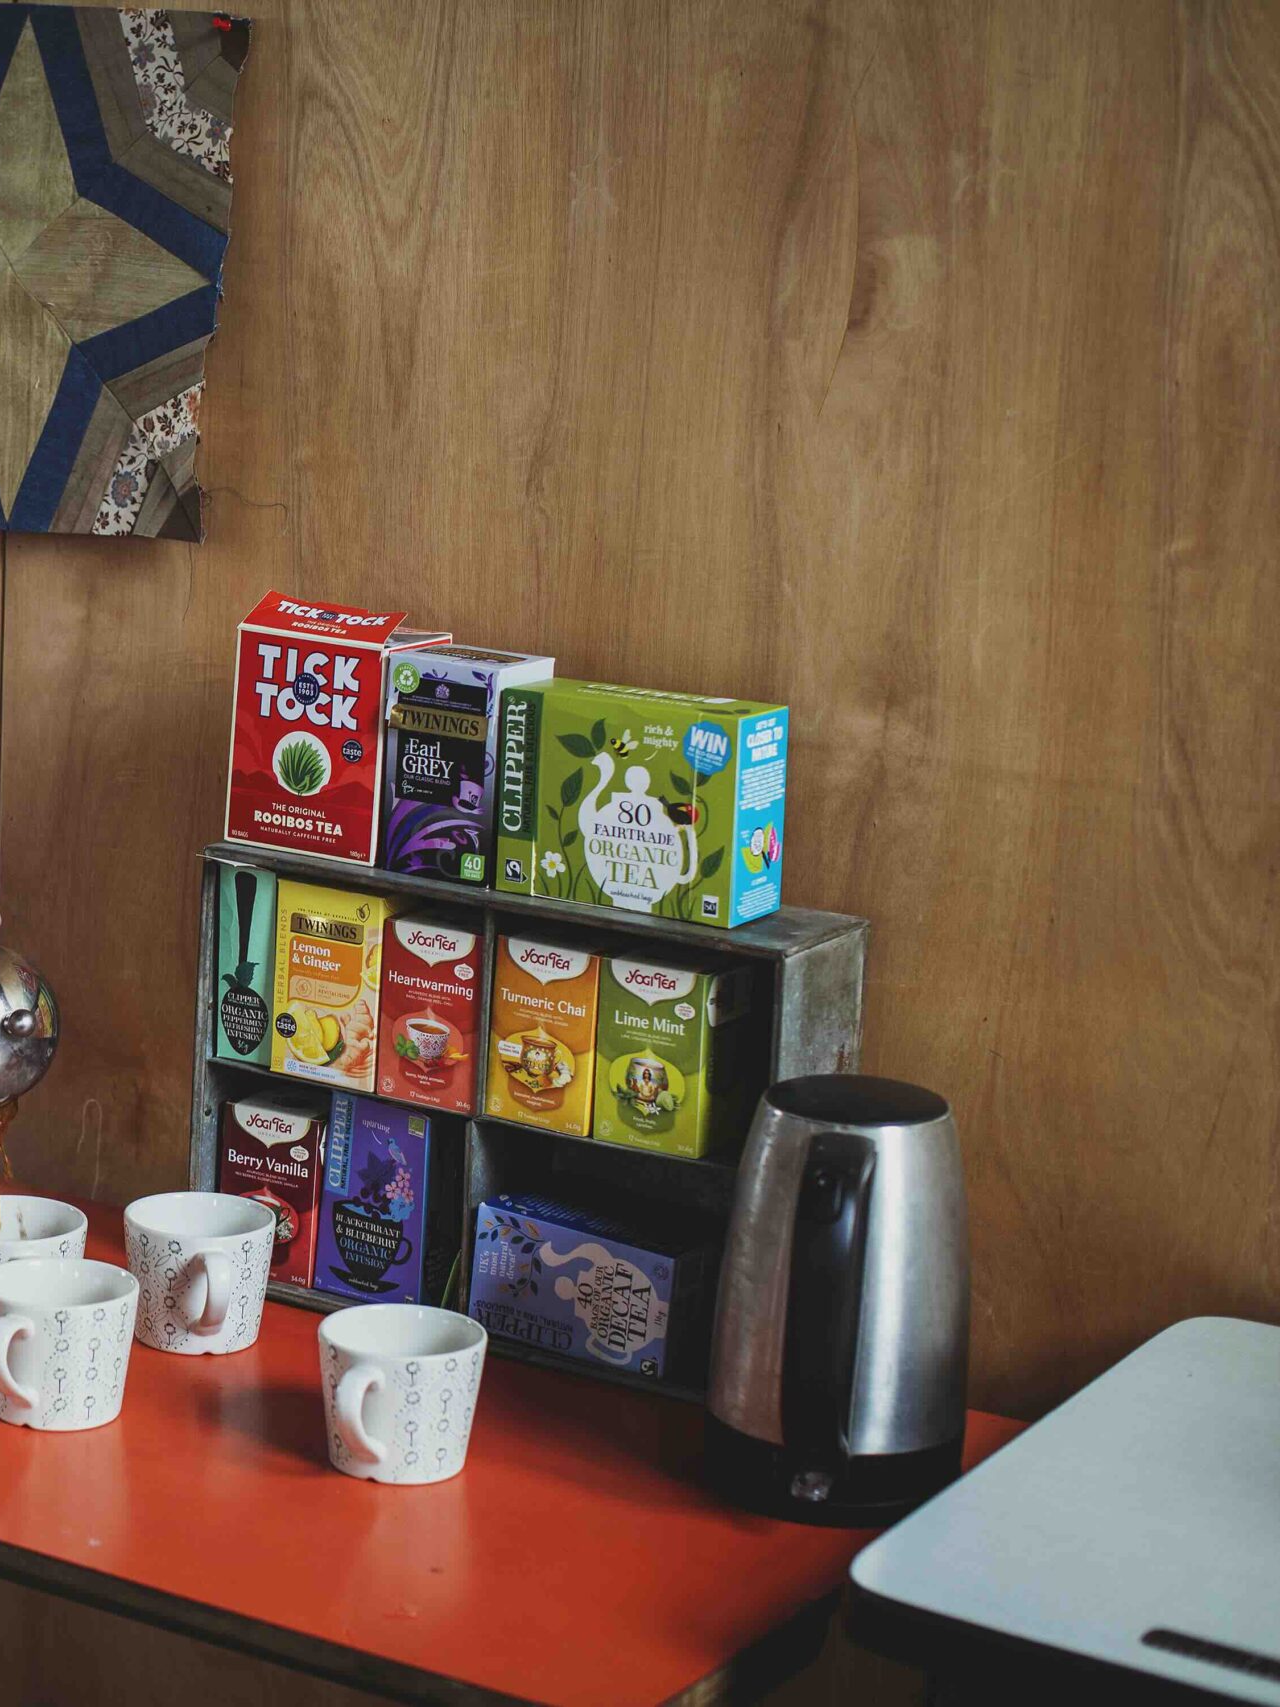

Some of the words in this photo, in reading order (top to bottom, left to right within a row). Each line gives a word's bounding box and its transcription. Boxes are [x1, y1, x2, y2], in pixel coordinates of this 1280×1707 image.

[277, 600, 322, 620] TICK
[336, 614, 390, 626] TOCK
[292, 622, 328, 632] ROOIBOS
[258, 644, 360, 692] TICK
[256, 682, 358, 731] TOCK
[402, 708, 480, 736] TWININGS
[644, 724, 664, 735] rich
[664, 727, 674, 737] &
[343, 747, 362, 757] taste
[410, 738, 441, 759] Earl
[643, 735, 679, 752] mighty
[690, 726, 728, 756] WIN
[402, 754, 454, 780] GREY
[502, 700, 528, 832] CLIPPER
[415, 775, 434, 783] CLASSIC
[272, 802, 286, 812] THE
[288, 806, 326, 819] ORIGINAL
[618, 801, 652, 826] 80
[238, 830, 249, 838] BAGS
[254, 810, 313, 831] ROOIBOS
[316, 821, 342, 836] TEA
[260, 826, 292, 836] NATURALLY
[293, 831, 320, 841] CAFFEINE
[322, 836, 336, 844] FREE
[594, 823, 676, 846] FAIRTRADE
[464, 856, 481, 871] 40
[589, 839, 678, 866] ORGANIC
[606, 860, 660, 890] TEA
[610, 890, 641, 900] unbleached
[280, 908, 288, 954] BLENDS
[297, 916, 357, 940] TWININGS
[293, 940, 331, 958] Lemon
[408, 931, 434, 948] YOGI
[436, 934, 456, 952] TEA
[292, 953, 300, 964] &
[303, 954, 341, 972] Ginger
[520, 948, 548, 966] YOGI
[549, 952, 570, 971] TEA
[276, 960, 286, 1004] HERBAL
[389, 970, 474, 1001] Heartwarming
[626, 970, 654, 987] YOGI
[654, 973, 676, 991] TEA
[228, 992, 260, 1004] CLIPPER
[501, 988, 555, 1011] Turmeric
[558, 1000, 586, 1018] Chai
[222, 1004, 268, 1020] ORGANIC
[615, 1010, 650, 1030] Lime
[653, 1016, 686, 1036] Mint
[228, 1029, 261, 1042] INFUSION
[276, 1021, 296, 1032] taste
[456, 1100, 471, 1110] 30.6g
[246, 1114, 272, 1130] YOGI
[272, 1117, 292, 1135] TEA
[362, 1119, 391, 1134] uplifting
[328, 1100, 348, 1188] CLIPPER
[228, 1148, 264, 1170] Berry
[266, 1156, 309, 1178] Vanilla
[336, 1213, 400, 1239] BLACKCURRANT
[336, 1224, 344, 1234] &
[346, 1228, 399, 1250] BLUEBERRY
[340, 1236, 392, 1260] ORGANIC
[499, 1241, 509, 1278] natural
[346, 1251, 386, 1270] INFUSION
[479, 1250, 490, 1274] UK's
[490, 1252, 499, 1276] most
[595, 1266, 604, 1287] OUR
[577, 1282, 594, 1310] 40
[593, 1288, 602, 1302] OF
[598, 1266, 614, 1339] ORGANIC
[608, 1262, 633, 1350] DECAF
[590, 1304, 600, 1330] BAGS
[628, 1285, 652, 1342] TEA
[476, 1308, 573, 1350] CLIPPER
